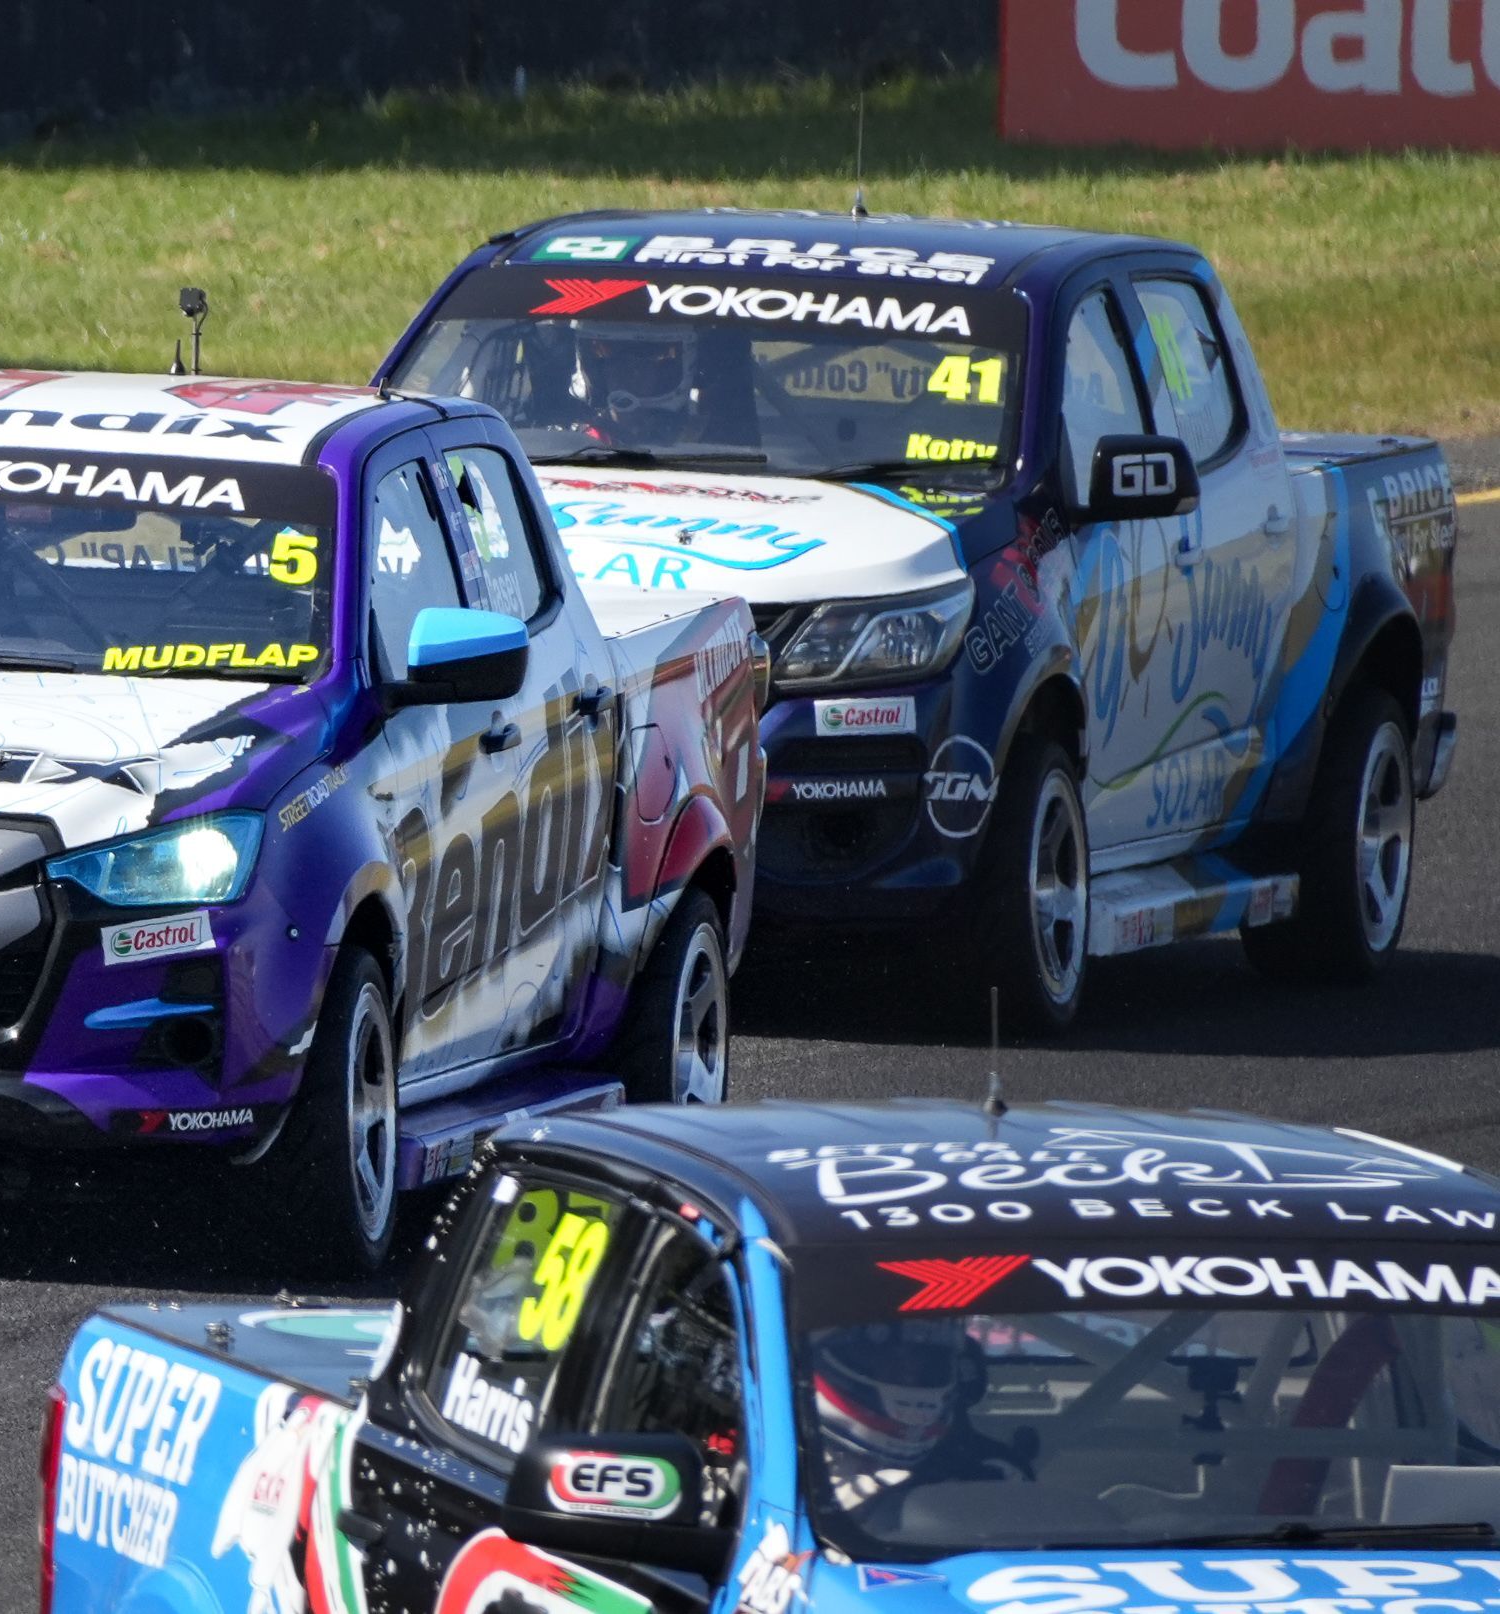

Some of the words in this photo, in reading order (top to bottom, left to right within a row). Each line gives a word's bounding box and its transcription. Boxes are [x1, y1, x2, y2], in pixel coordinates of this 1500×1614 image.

[1073, 0, 1500, 96] Coat
[762, 252, 846, 271] For
[856, 258, 982, 286] Steel
[646, 284, 972, 337] YOKOHAMA
[927, 356, 1002, 404] 41
[268, 532, 319, 586] 5
[549, 500, 827, 571] Sunny
[102, 643, 319, 673] MUDFLAP
[844, 704, 901, 728] Castrol
[791, 779, 887, 800] YOKOHAMA
[132, 921, 198, 952] Castrol
[167, 1107, 255, 1132] YOKOHAMA
[783, 1148, 1242, 1205] Beck
[840, 1201, 1033, 1230] 1300
[1069, 1198, 1294, 1219] BECK
[1326, 1201, 1496, 1229] LAW
[518, 1212, 609, 1351] 58
[67, 1337, 221, 1485] SUPER
[442, 1351, 534, 1454] Harris
[571, 1463, 654, 1497] EFS
[55, 1451, 178, 1568] BUTCHER
